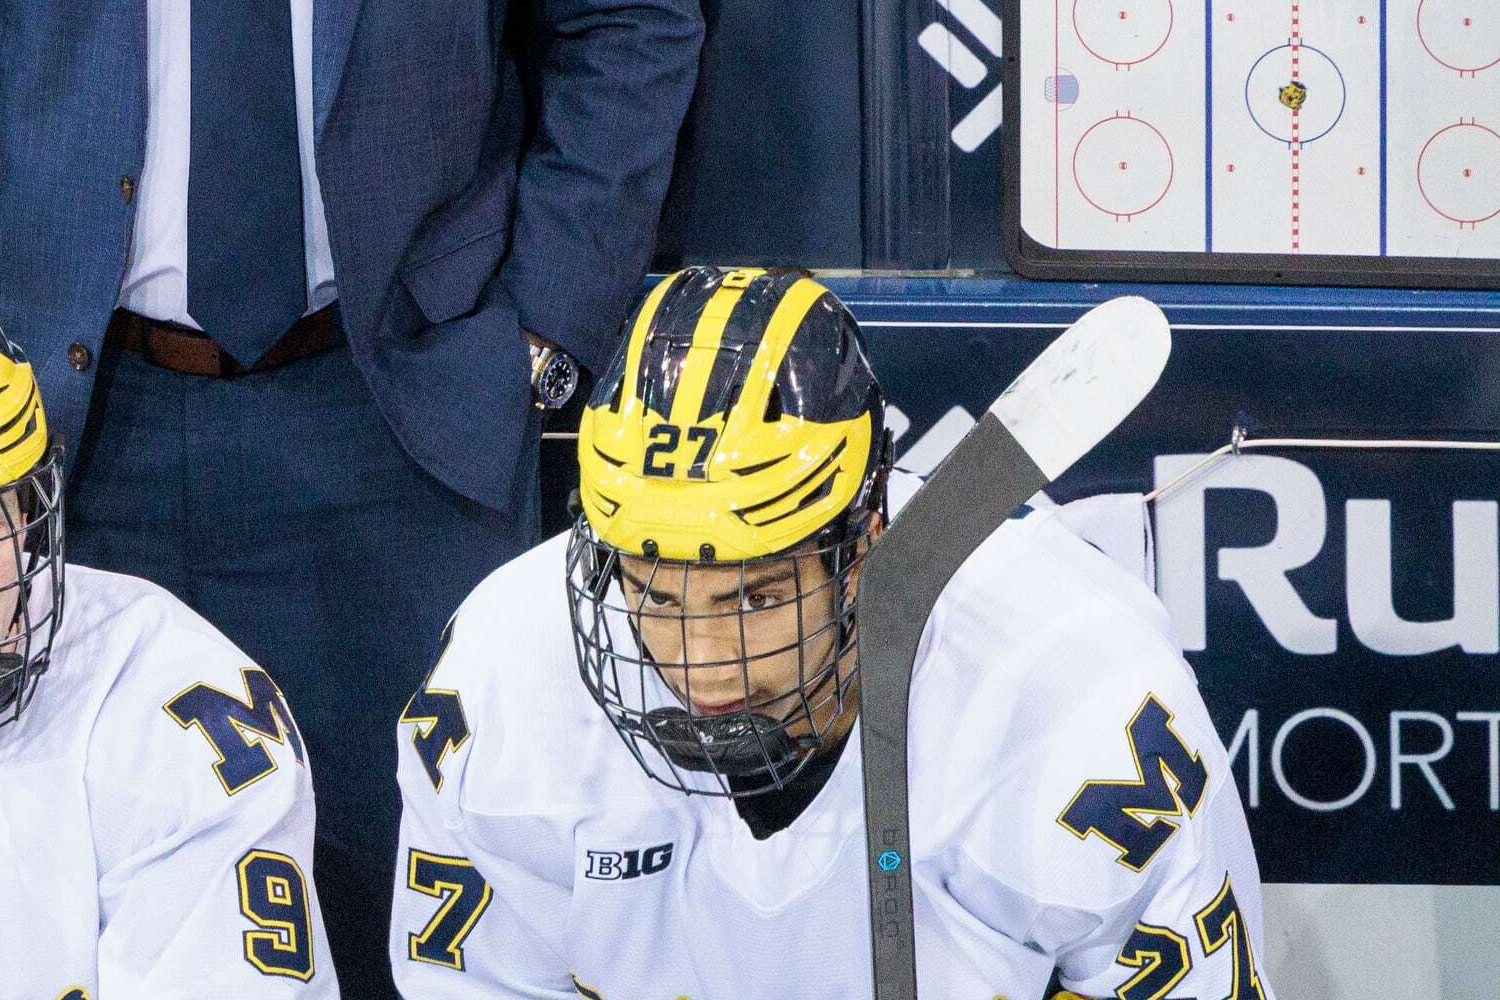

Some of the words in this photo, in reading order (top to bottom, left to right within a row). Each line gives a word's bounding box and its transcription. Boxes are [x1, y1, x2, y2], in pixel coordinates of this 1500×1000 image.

[643, 423, 719, 480] 27
[163, 667, 306, 796] M
[1056, 692, 1208, 873] M
[234, 847, 315, 984] 9
[407, 847, 494, 973] 7
[1115, 871, 1274, 1000] 27
